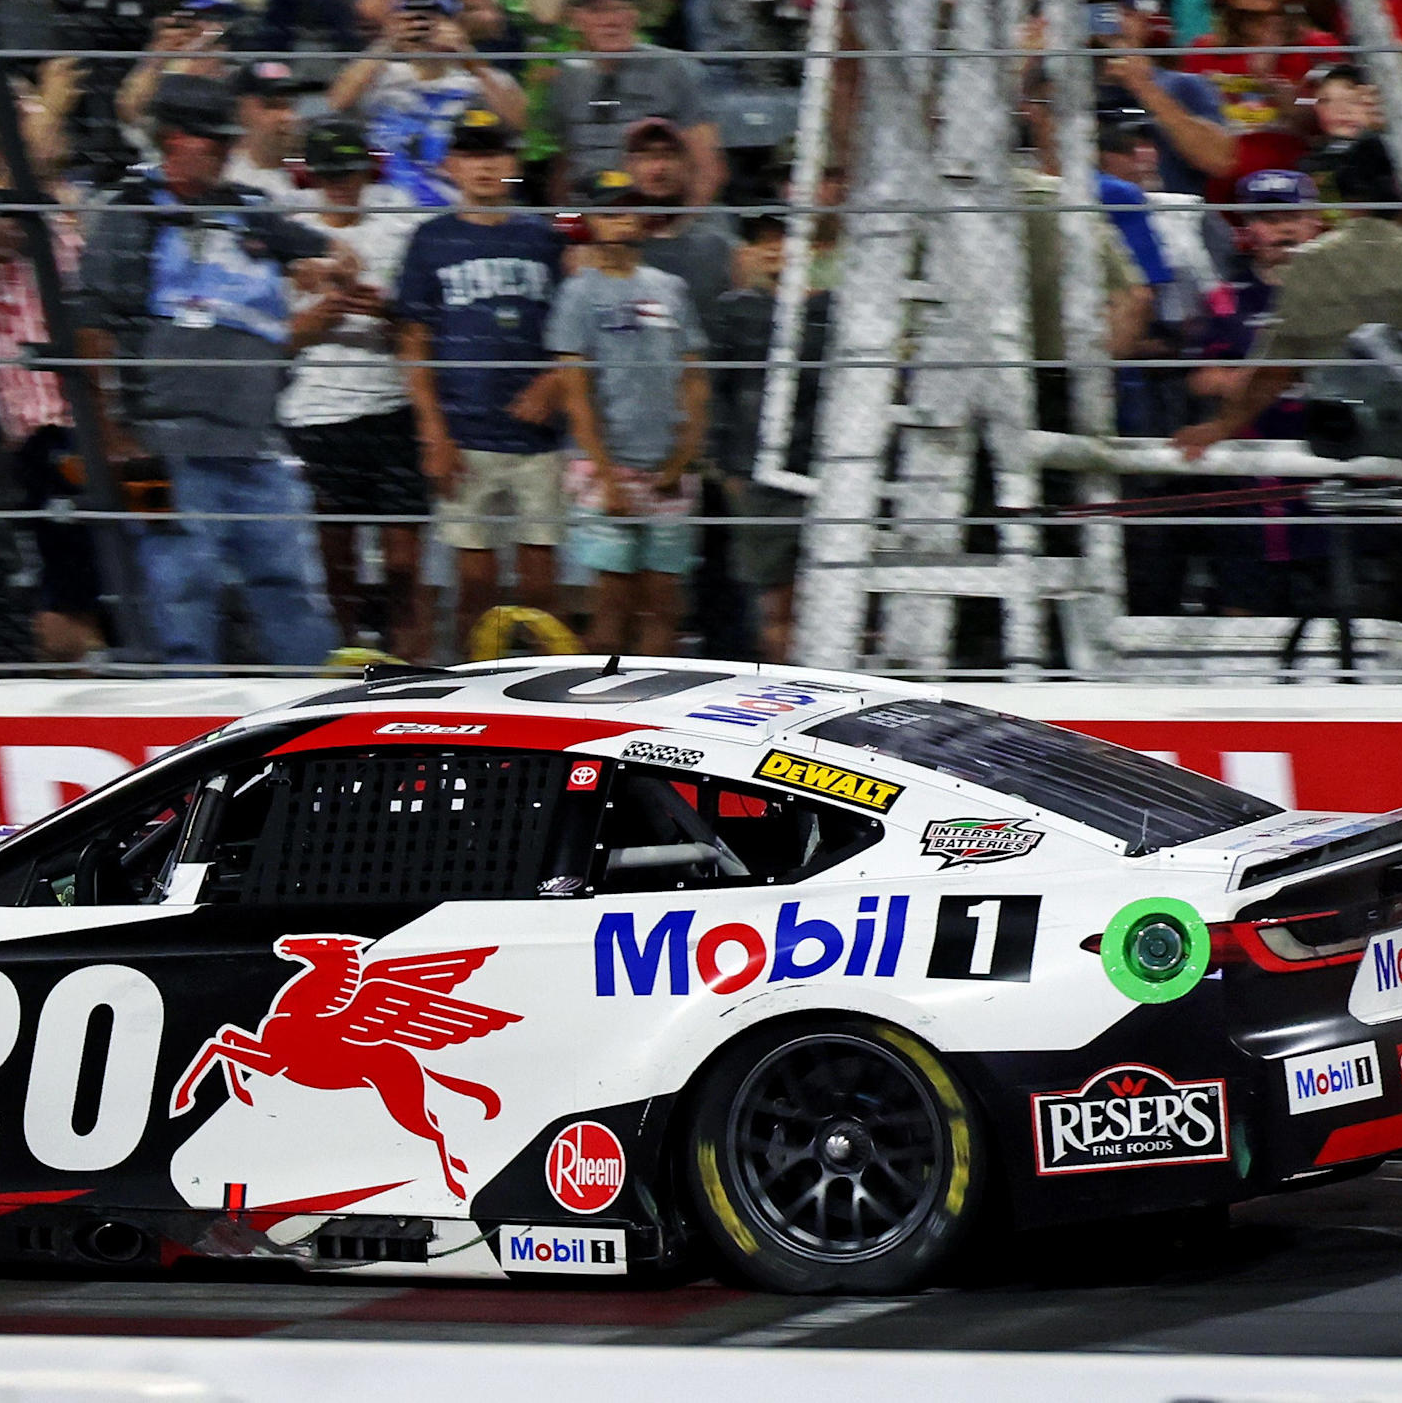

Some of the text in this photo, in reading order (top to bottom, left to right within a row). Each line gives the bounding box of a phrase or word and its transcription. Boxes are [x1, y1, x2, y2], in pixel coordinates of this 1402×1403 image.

[933, 827, 1034, 842] INTERSTATE
[934, 839, 1025, 851] BATTERIES
[594, 895, 1002, 997] Mobil 1
[1295, 1060, 1354, 1099] Mobil
[1048, 1089, 1215, 1163] RESER'S
[555, 1125, 620, 1198] Rheem
[1092, 1140, 1174, 1157] FINE FOODS
[510, 1236, 585, 1263] Mobil
